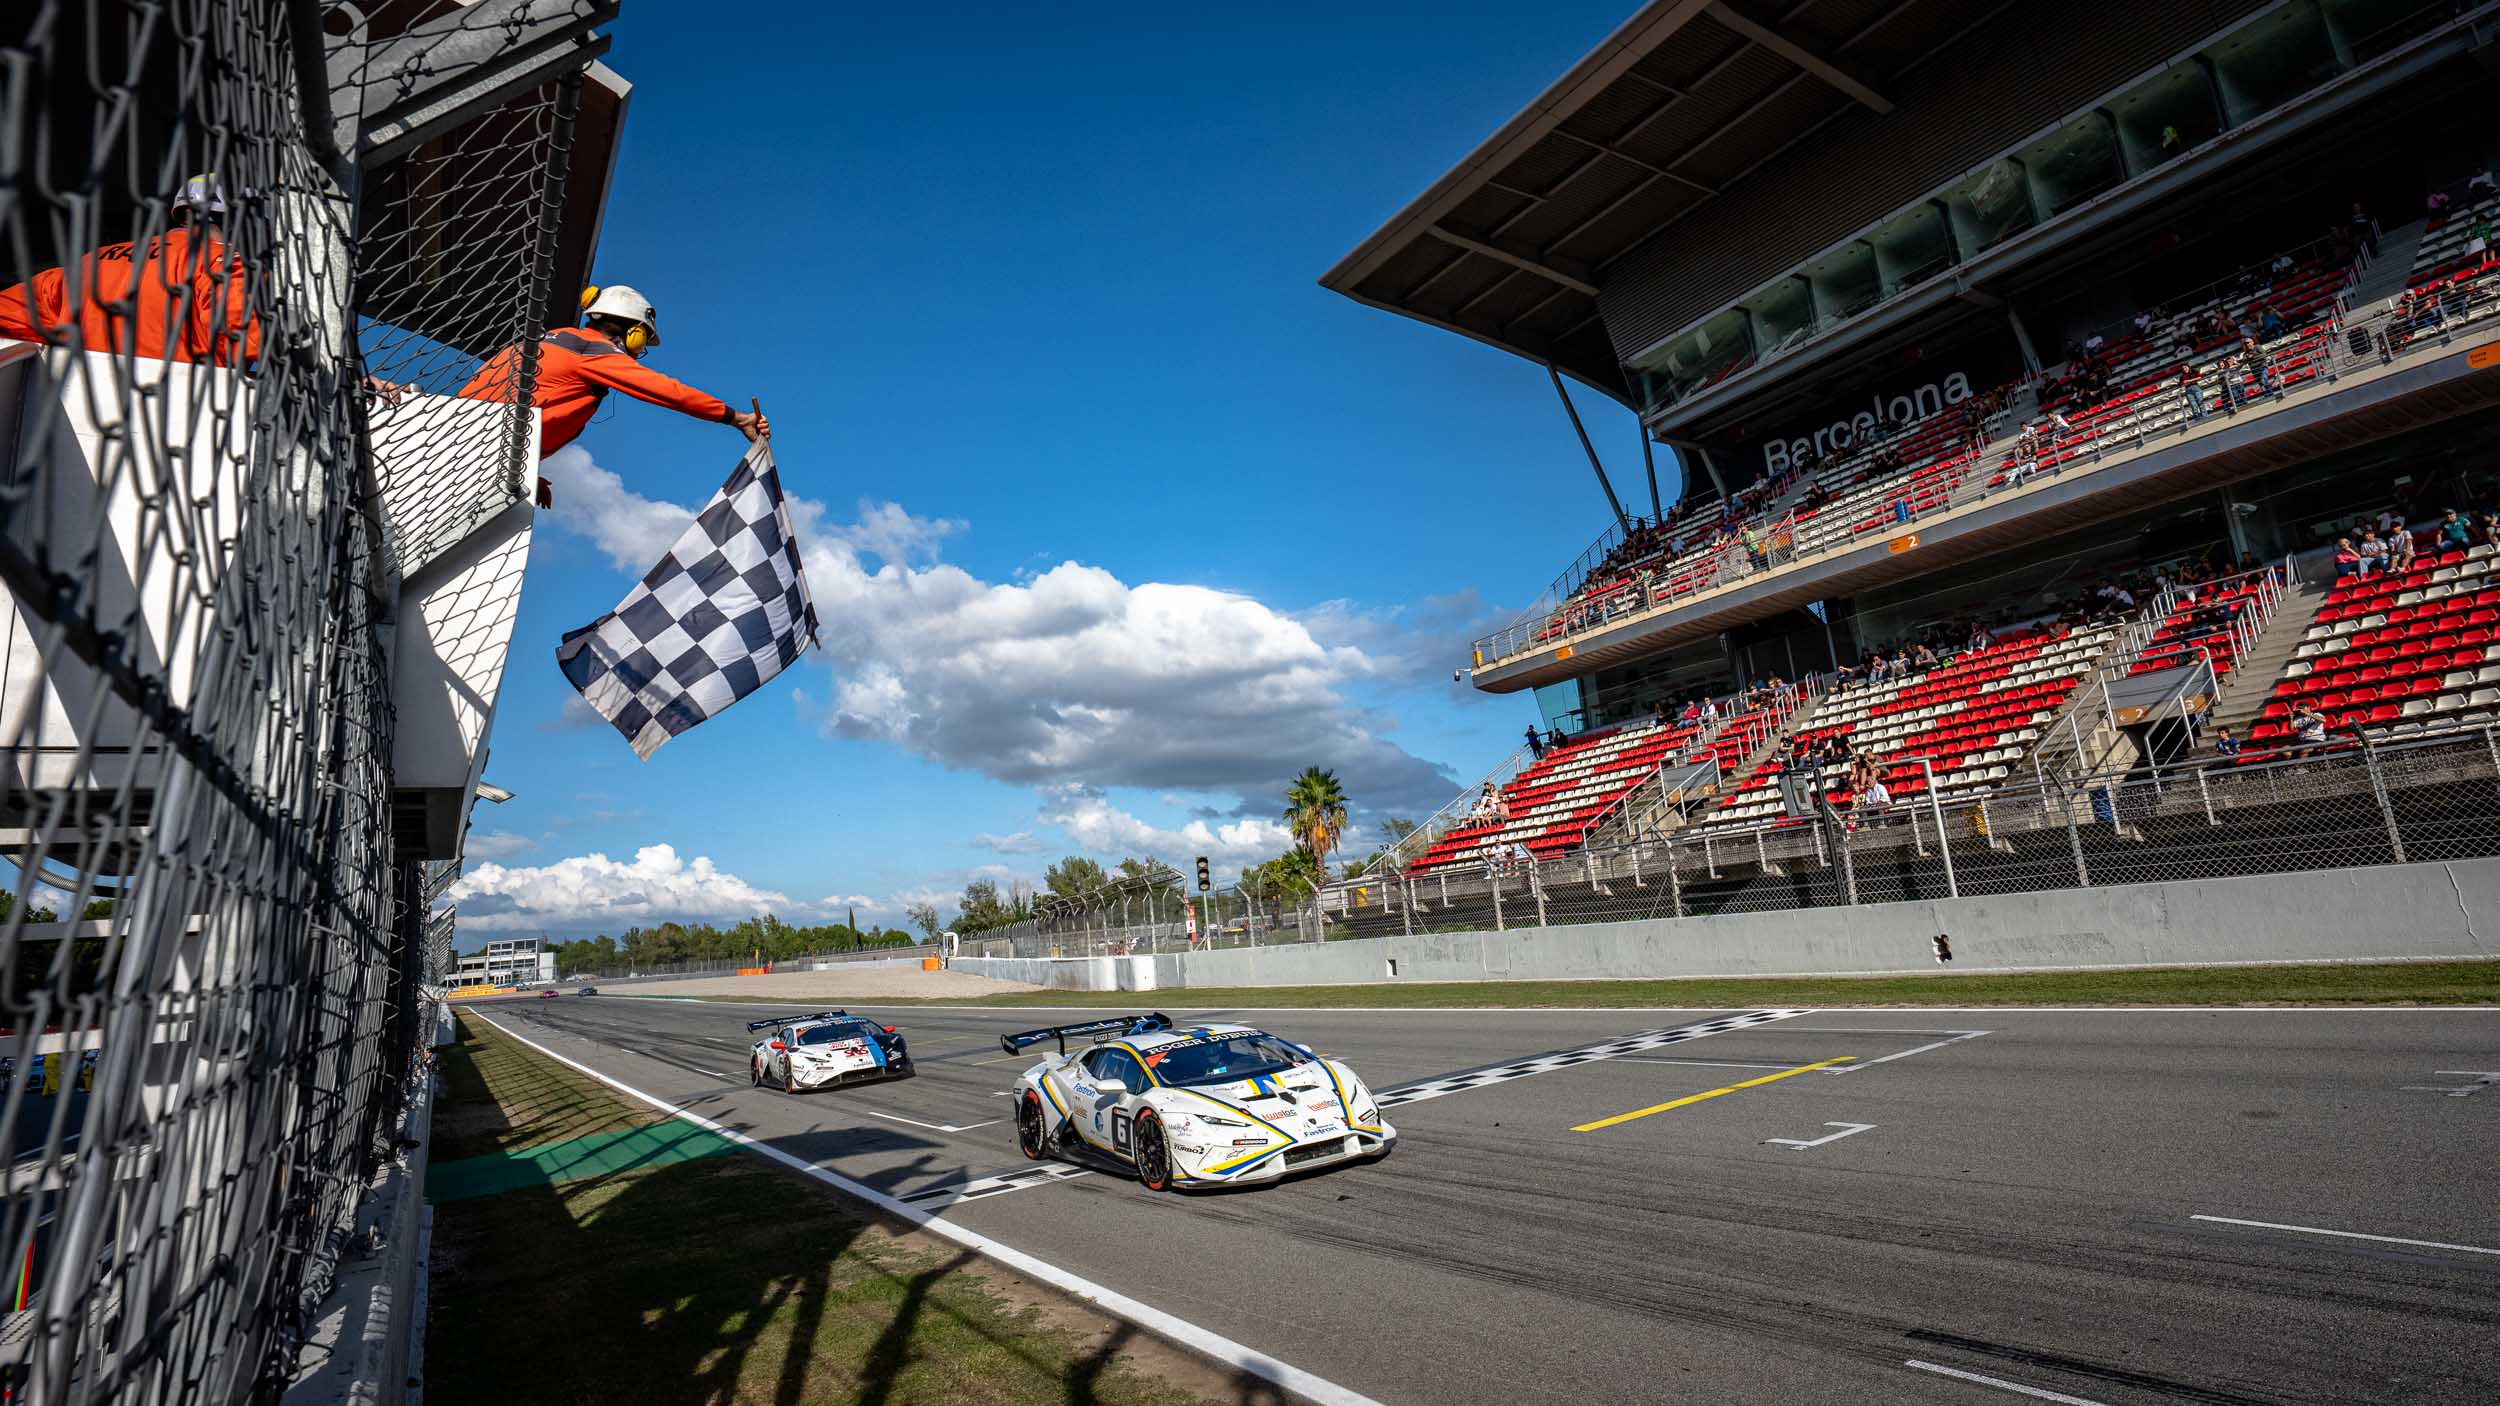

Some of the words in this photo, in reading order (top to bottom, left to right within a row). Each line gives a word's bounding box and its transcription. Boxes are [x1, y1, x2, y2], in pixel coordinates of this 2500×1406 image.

[1763, 371, 1973, 476] Barcelona
[1908, 535, 1918, 548] 2
[1148, 1038, 1206, 1055] ROGER
[1206, 1029, 1263, 1042] DUBUIS
[1073, 1083, 1096, 1098] Fastron
[1117, 1117, 1127, 1144] 6
[1303, 1126, 1339, 1138] Fastron
